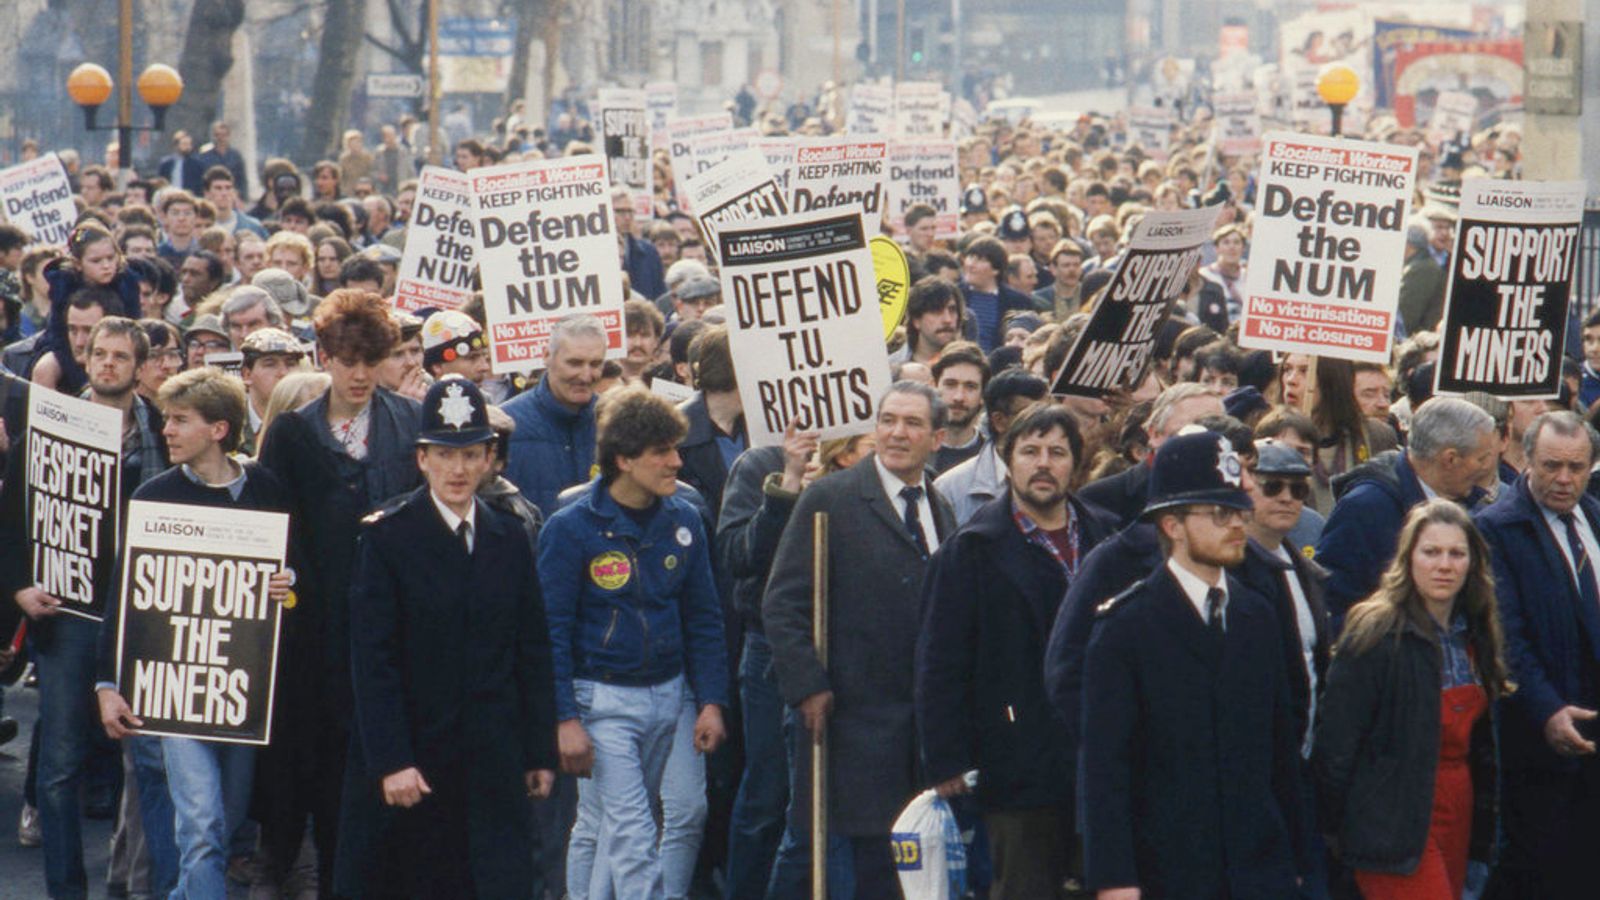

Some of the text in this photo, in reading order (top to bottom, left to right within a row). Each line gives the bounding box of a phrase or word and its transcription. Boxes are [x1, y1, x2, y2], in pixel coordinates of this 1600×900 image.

[798, 165, 830, 180] KEEP
[832, 160, 882, 177] FIGHTING
[891, 165, 954, 181] Defend
[1273, 142, 1408, 171] Socialist Worker
[548, 165, 600, 184] Worker
[909, 182, 938, 196] the
[1271, 161, 1406, 190] KEEP FIGHTING
[7, 179, 69, 216] Defend
[423, 187, 454, 202] KEEP
[479, 192, 521, 209] KEEP
[527, 181, 603, 203] FIGHTING
[1263, 184, 1405, 231] Defend
[1477, 194, 1532, 208] LIAISON
[31, 209, 61, 228] the
[480, 203, 610, 249] Defend
[436, 235, 473, 262] the
[729, 238, 786, 257] LIAISON
[1297, 226, 1361, 262] the
[1462, 226, 1578, 282] SUPPORT
[518, 245, 579, 278] the
[506, 274, 601, 315] NUM
[732, 260, 862, 330] DEFEND
[1272, 259, 1376, 302] NUM
[1122, 303, 1166, 343] THE
[1252, 297, 1386, 327] No victimisations
[1498, 284, 1546, 328] THE
[495, 325, 516, 340] No
[778, 328, 833, 371] T.U.
[1259, 320, 1373, 347] No pit closures
[508, 343, 528, 358] No
[1455, 326, 1553, 385] MINERS
[36, 402, 68, 423] LIAISON
[758, 367, 873, 433] RIGHTS
[29, 431, 115, 508] RESPECT
[33, 491, 102, 558] PICKET
[144, 521, 205, 537] LIAISON
[33, 542, 94, 605] LINES
[133, 553, 277, 620] SUPPORT
[169, 616, 232, 666] THE
[132, 659, 249, 727] MINERS
